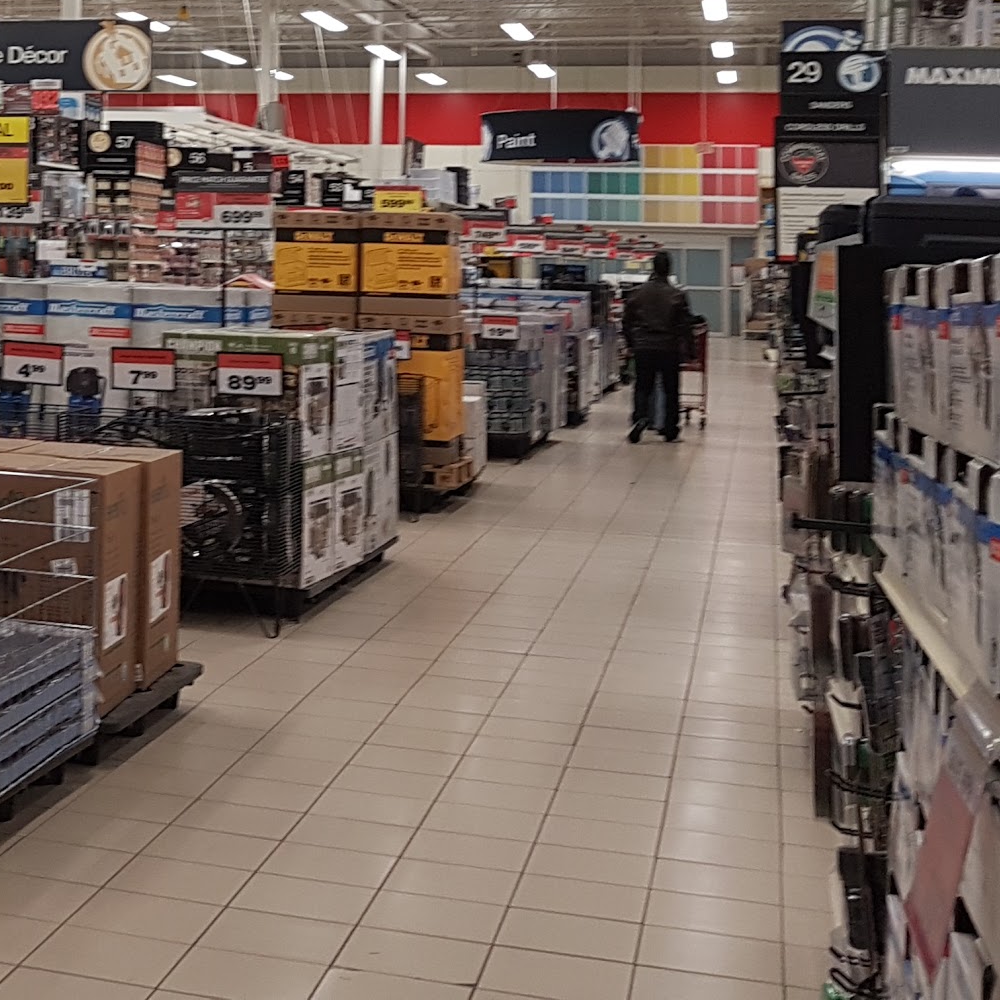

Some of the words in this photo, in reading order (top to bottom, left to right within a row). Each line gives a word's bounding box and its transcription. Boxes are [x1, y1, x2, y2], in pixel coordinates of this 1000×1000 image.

[7, 46, 68, 65] Décor
[786, 61, 823, 84] 29
[115, 135, 135, 149] 57
[496, 132, 537, 149] Paint
[188, 152, 206, 165] 56
